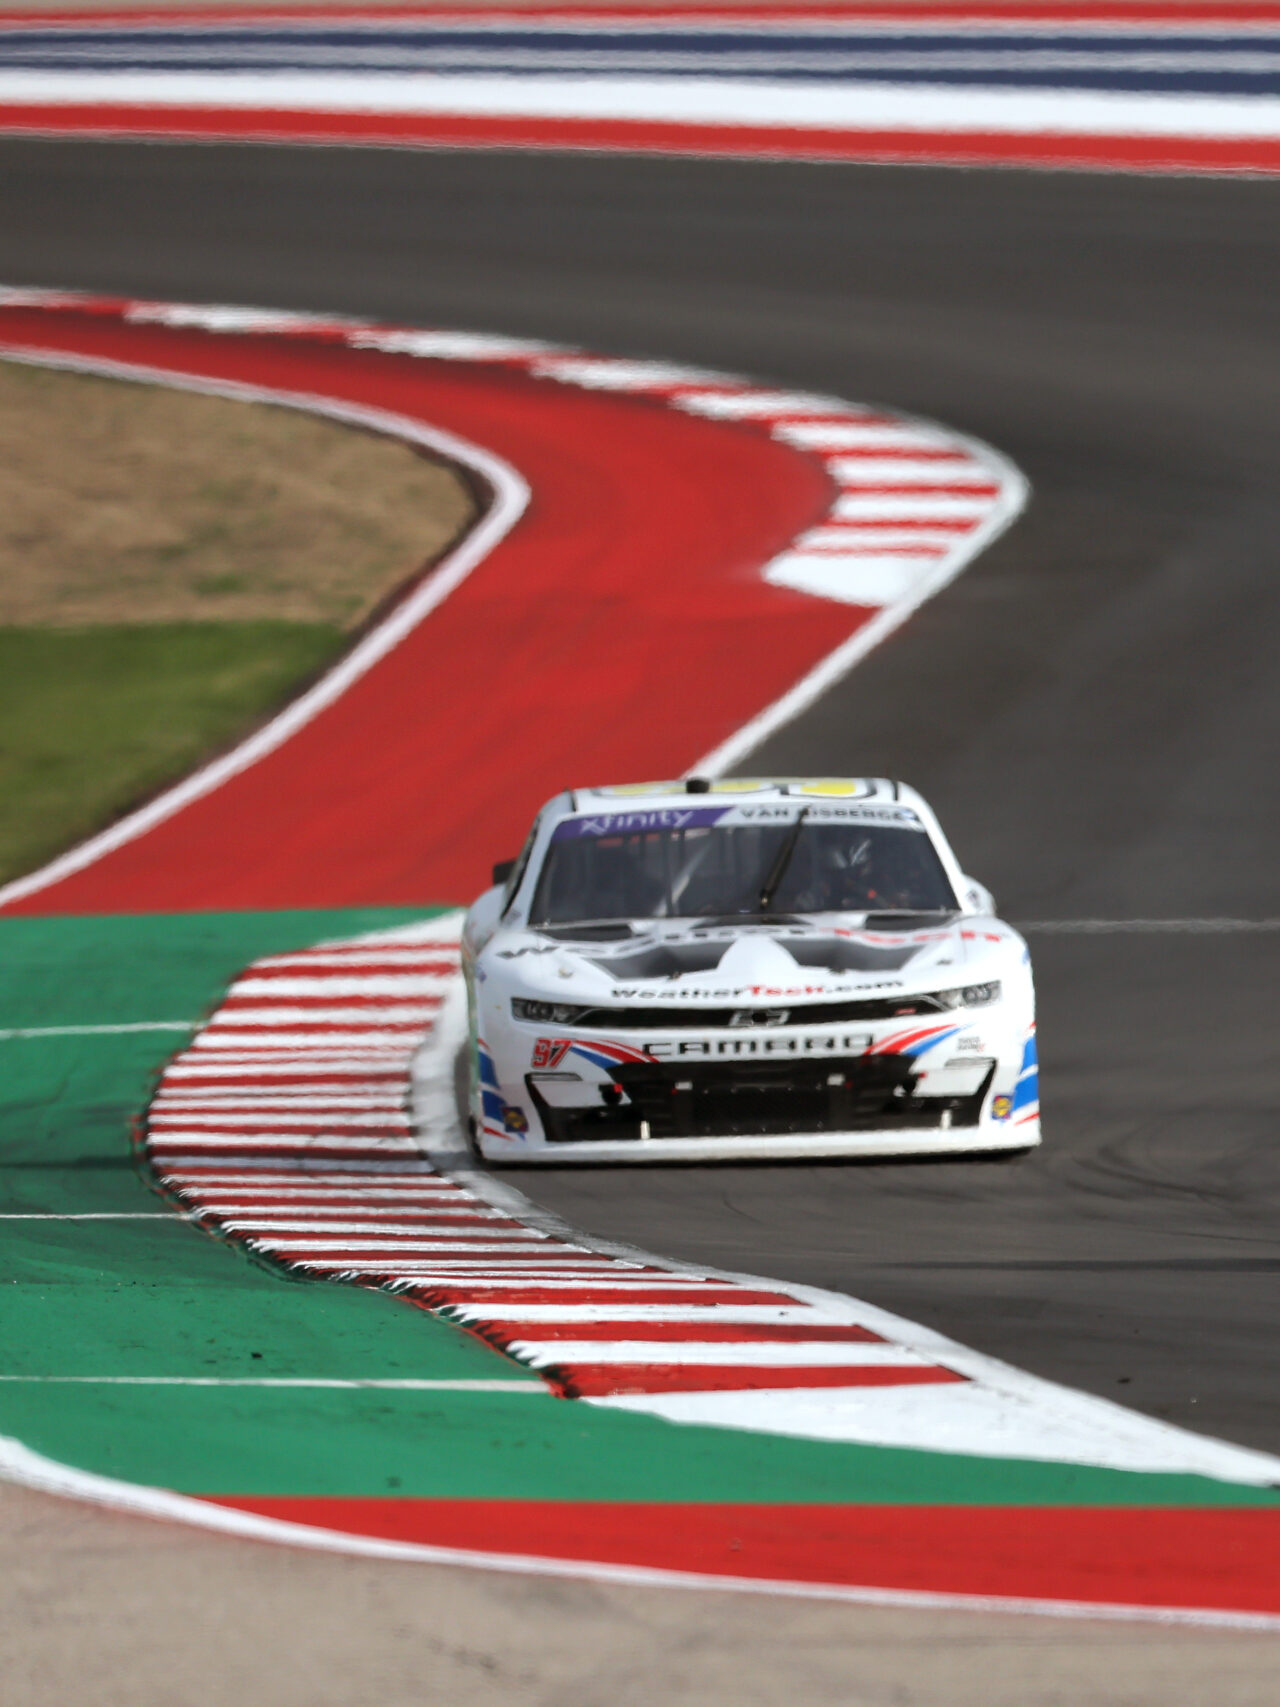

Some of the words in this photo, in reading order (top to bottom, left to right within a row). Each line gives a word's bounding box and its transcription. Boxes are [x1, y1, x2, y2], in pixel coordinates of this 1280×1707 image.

[580, 810, 693, 836] xfinity
[741, 807, 788, 819] VAN
[611, 979, 904, 999] WeatherTech.com
[531, 1037, 573, 1069] 97
[642, 1033, 874, 1056] CAMARO
